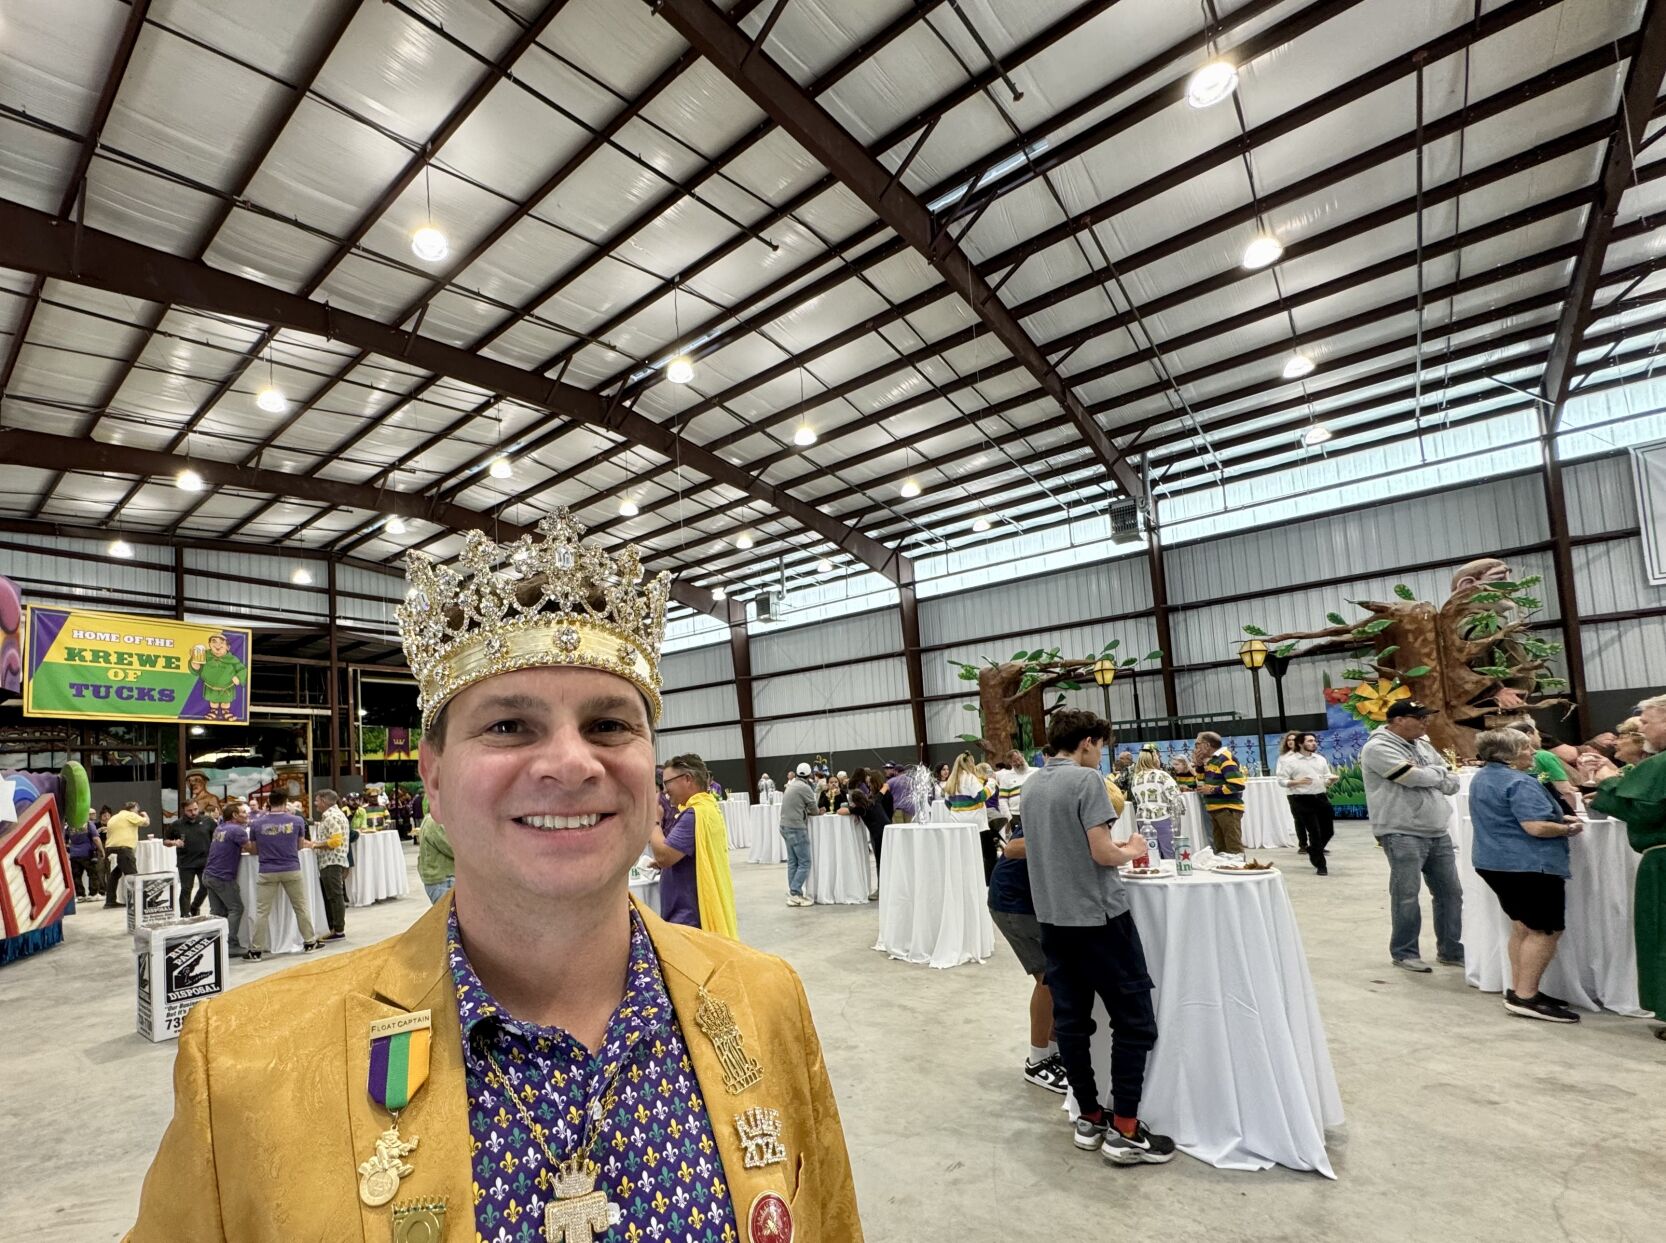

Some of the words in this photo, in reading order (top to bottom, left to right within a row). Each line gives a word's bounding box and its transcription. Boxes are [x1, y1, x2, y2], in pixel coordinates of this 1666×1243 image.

[72, 629, 120, 642] HOME
[123, 635, 144, 645] OF
[145, 636, 174, 648] THE
[64, 647, 181, 670] KREWE
[107, 668, 142, 681] OF
[69, 682, 176, 702] TUCKS
[14, 826, 53, 920] F
[173, 938, 210, 965] PARISH
[168, 984, 220, 1000] DISPOSAL
[371, 1022, 396, 1033] FLOAT
[397, 1015, 430, 1028] CAPTAIN
